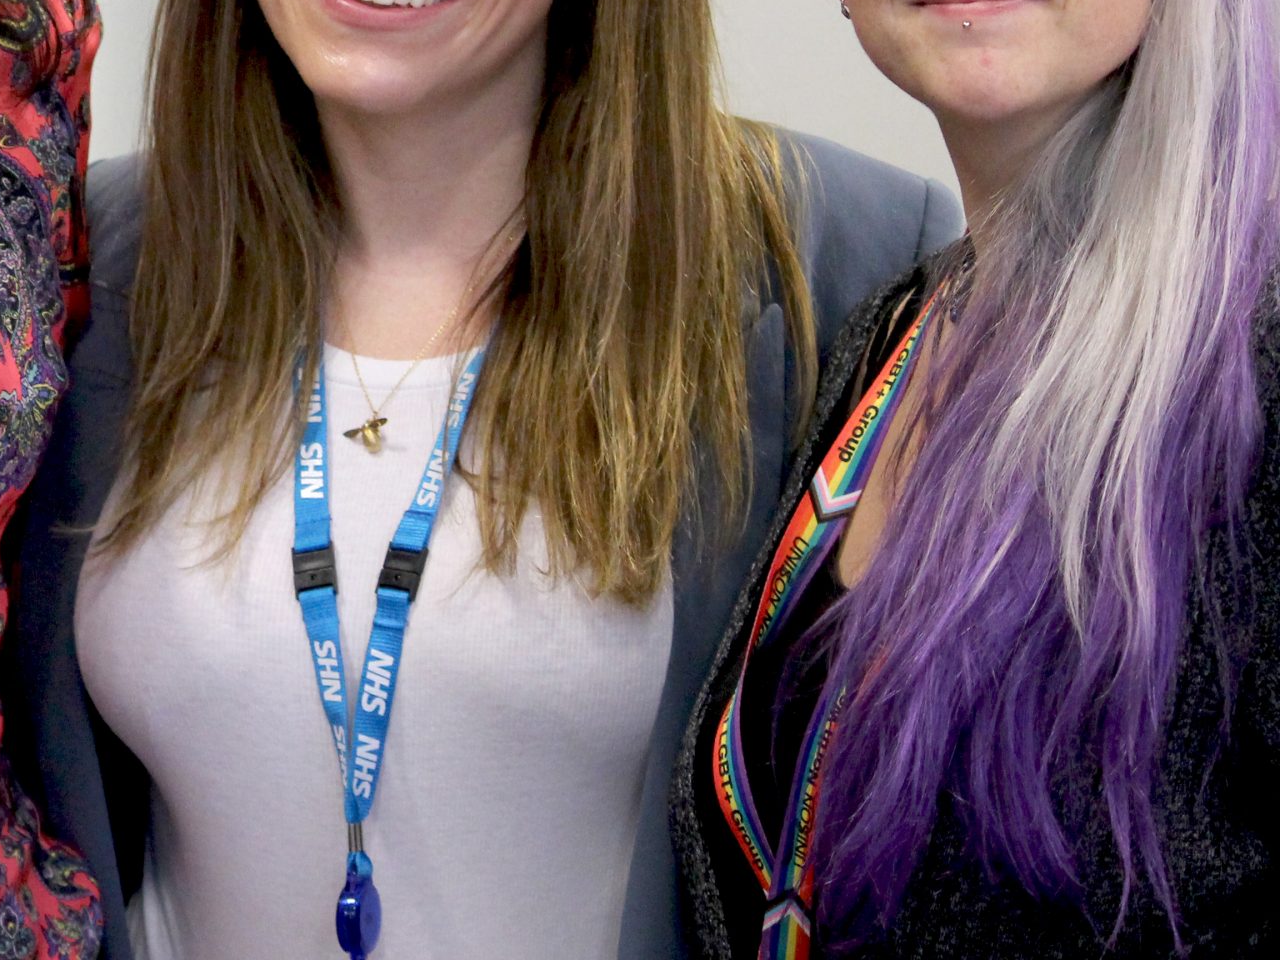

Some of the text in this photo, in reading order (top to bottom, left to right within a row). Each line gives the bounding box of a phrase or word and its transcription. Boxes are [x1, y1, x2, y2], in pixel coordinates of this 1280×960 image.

[447, 372, 476, 428] NHS
[838, 403, 879, 463] Group
[300, 442, 324, 500] NHS
[416, 448, 449, 508] NHS
[769, 536, 809, 609] UNISON
[314, 640, 342, 702] NHS
[361, 648, 394, 716] NHS
[352, 733, 381, 798] NHS
[731, 808, 765, 871] Group
